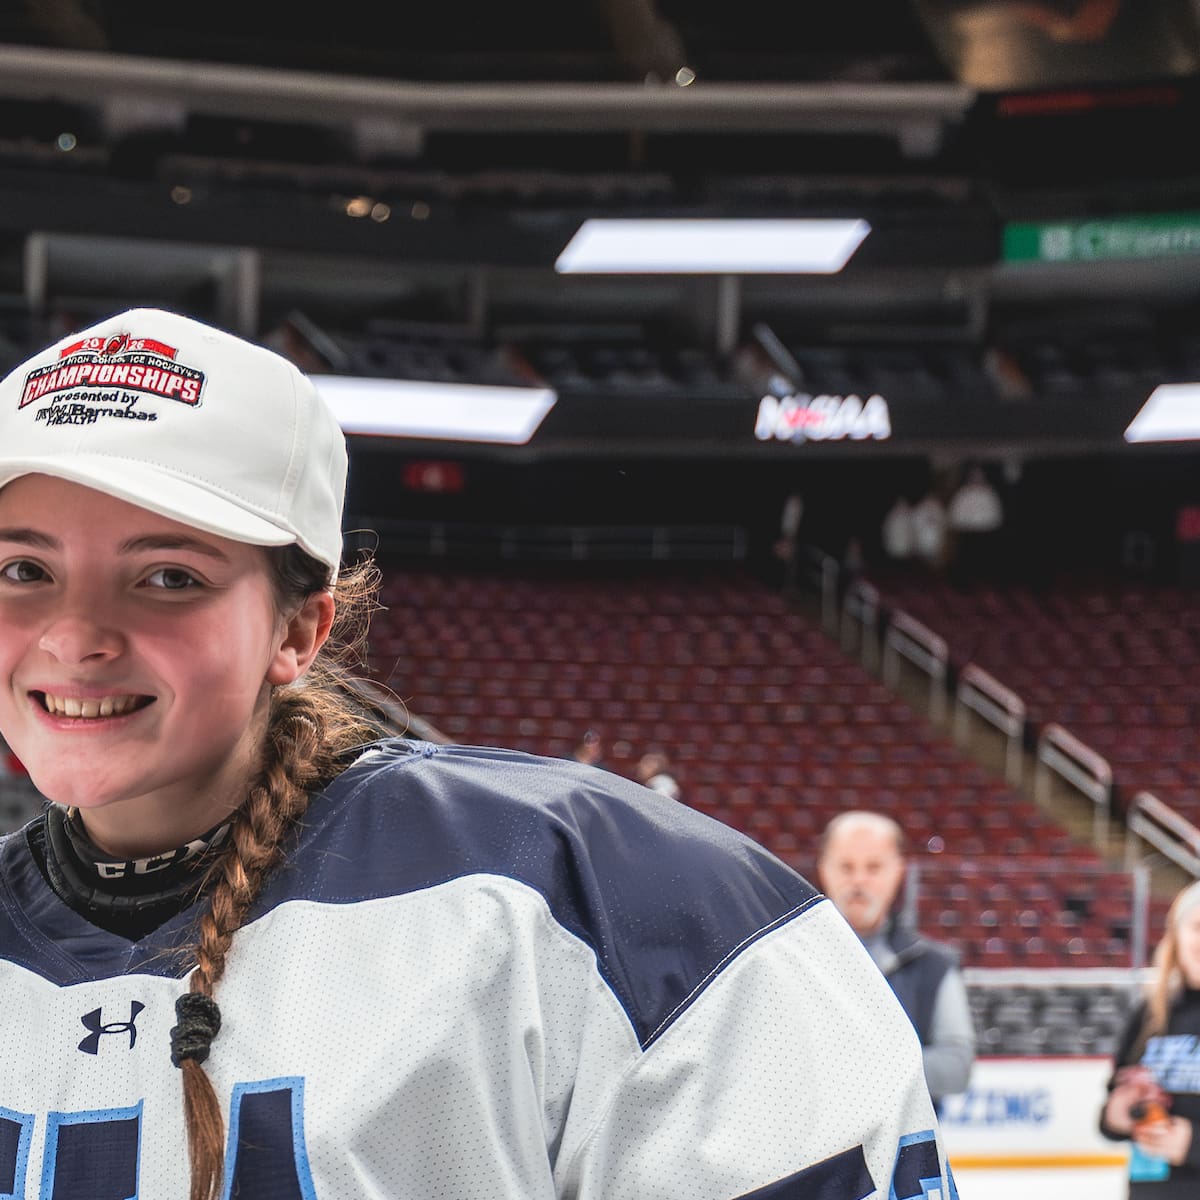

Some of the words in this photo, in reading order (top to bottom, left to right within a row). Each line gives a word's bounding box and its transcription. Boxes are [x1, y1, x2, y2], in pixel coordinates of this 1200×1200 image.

[81, 338, 100, 349] 20
[130, 339, 145, 350] 26
[130, 355, 146, 364] ICE
[148, 357, 187, 375] HOCKEY
[21, 363, 201, 405] CHAMPIONSHIPS
[50, 391, 120, 407] presented
[121, 392, 139, 407] by
